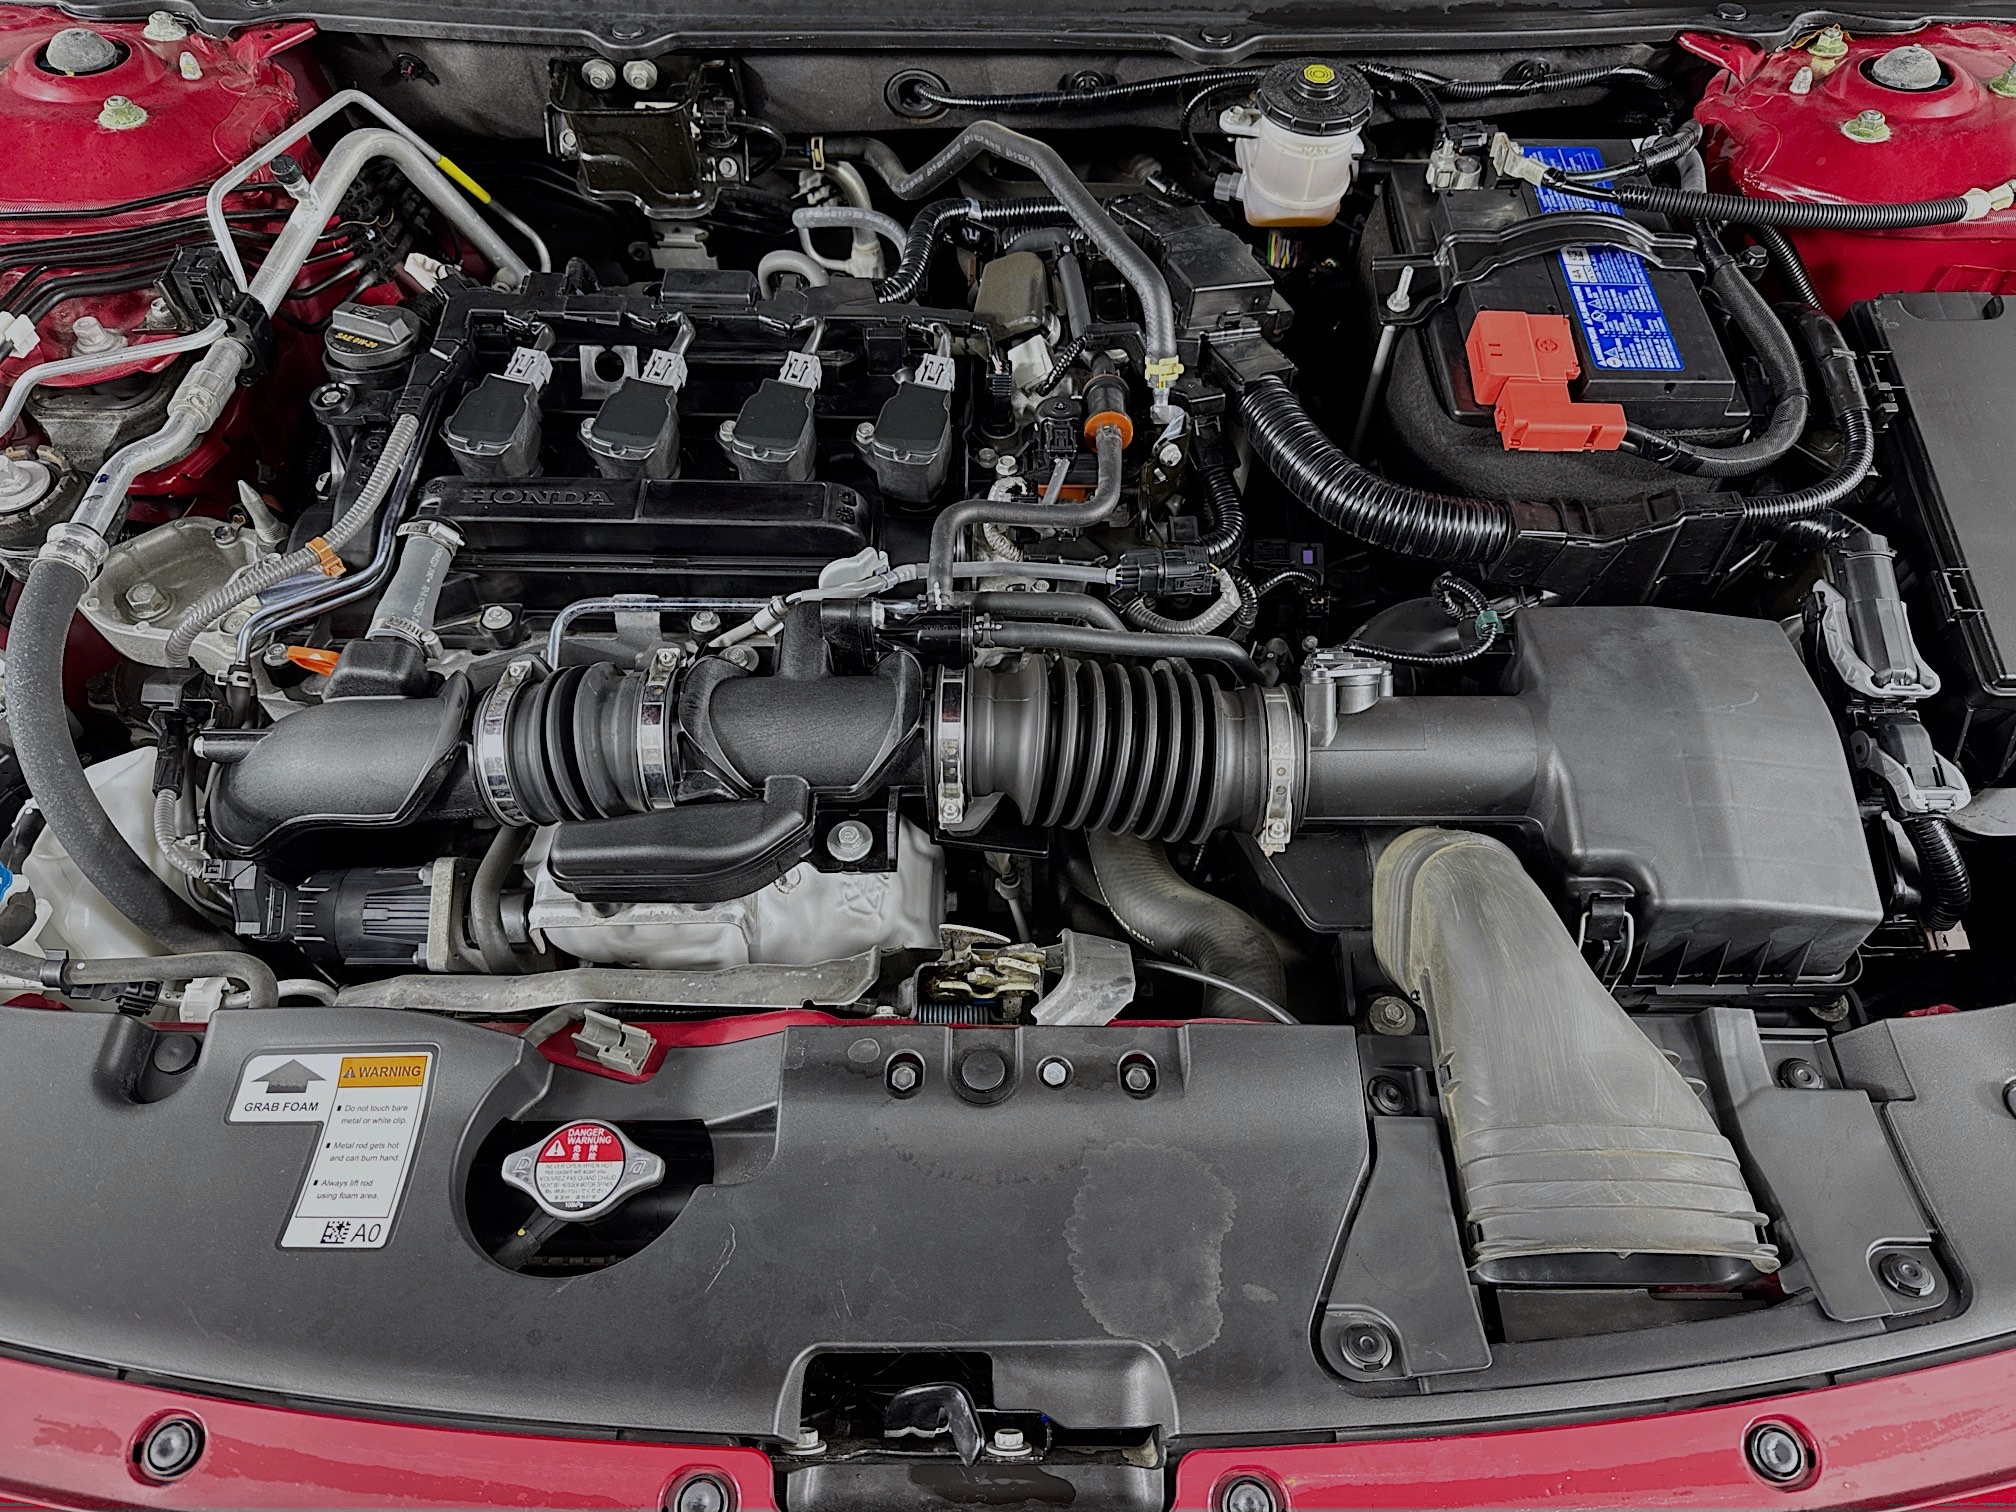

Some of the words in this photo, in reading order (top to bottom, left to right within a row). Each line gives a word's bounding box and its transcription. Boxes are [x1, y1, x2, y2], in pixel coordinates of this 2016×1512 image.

[1303, 146, 1328, 156] MAX
[335, 332, 354, 341] SAE
[353, 337, 378, 348] 0W-20
[459, 489, 615, 506] HONDA
[359, 1066, 421, 1078] WARNING
[244, 1102, 280, 1112] GRAB
[282, 1102, 319, 1112] FOAM
[370, 1104, 390, 1112] touch
[391, 1104, 408, 1112] bare
[568, 1128, 604, 1136] DANGER
[567, 1136, 612, 1144] WARNUNG
[321, 1180, 348, 1188] Always
[350, 1223, 381, 1243] A0
